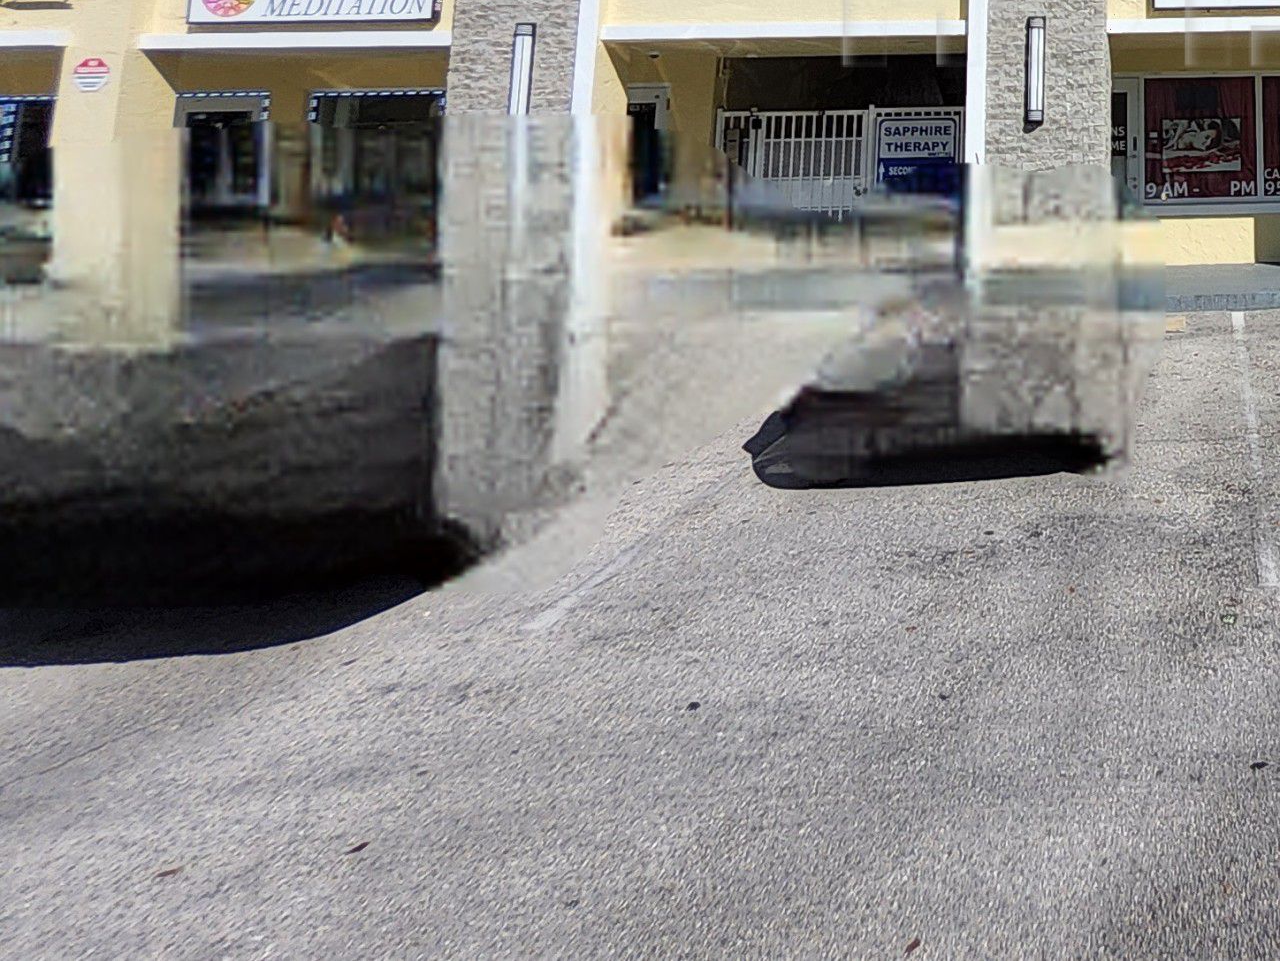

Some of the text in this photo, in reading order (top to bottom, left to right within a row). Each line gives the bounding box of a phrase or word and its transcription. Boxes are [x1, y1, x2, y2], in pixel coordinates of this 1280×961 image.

[884, 125, 952, 137] SAPPHIRE
[885, 141, 950, 153] THERAPY
[1230, 180, 1256, 196] PM
